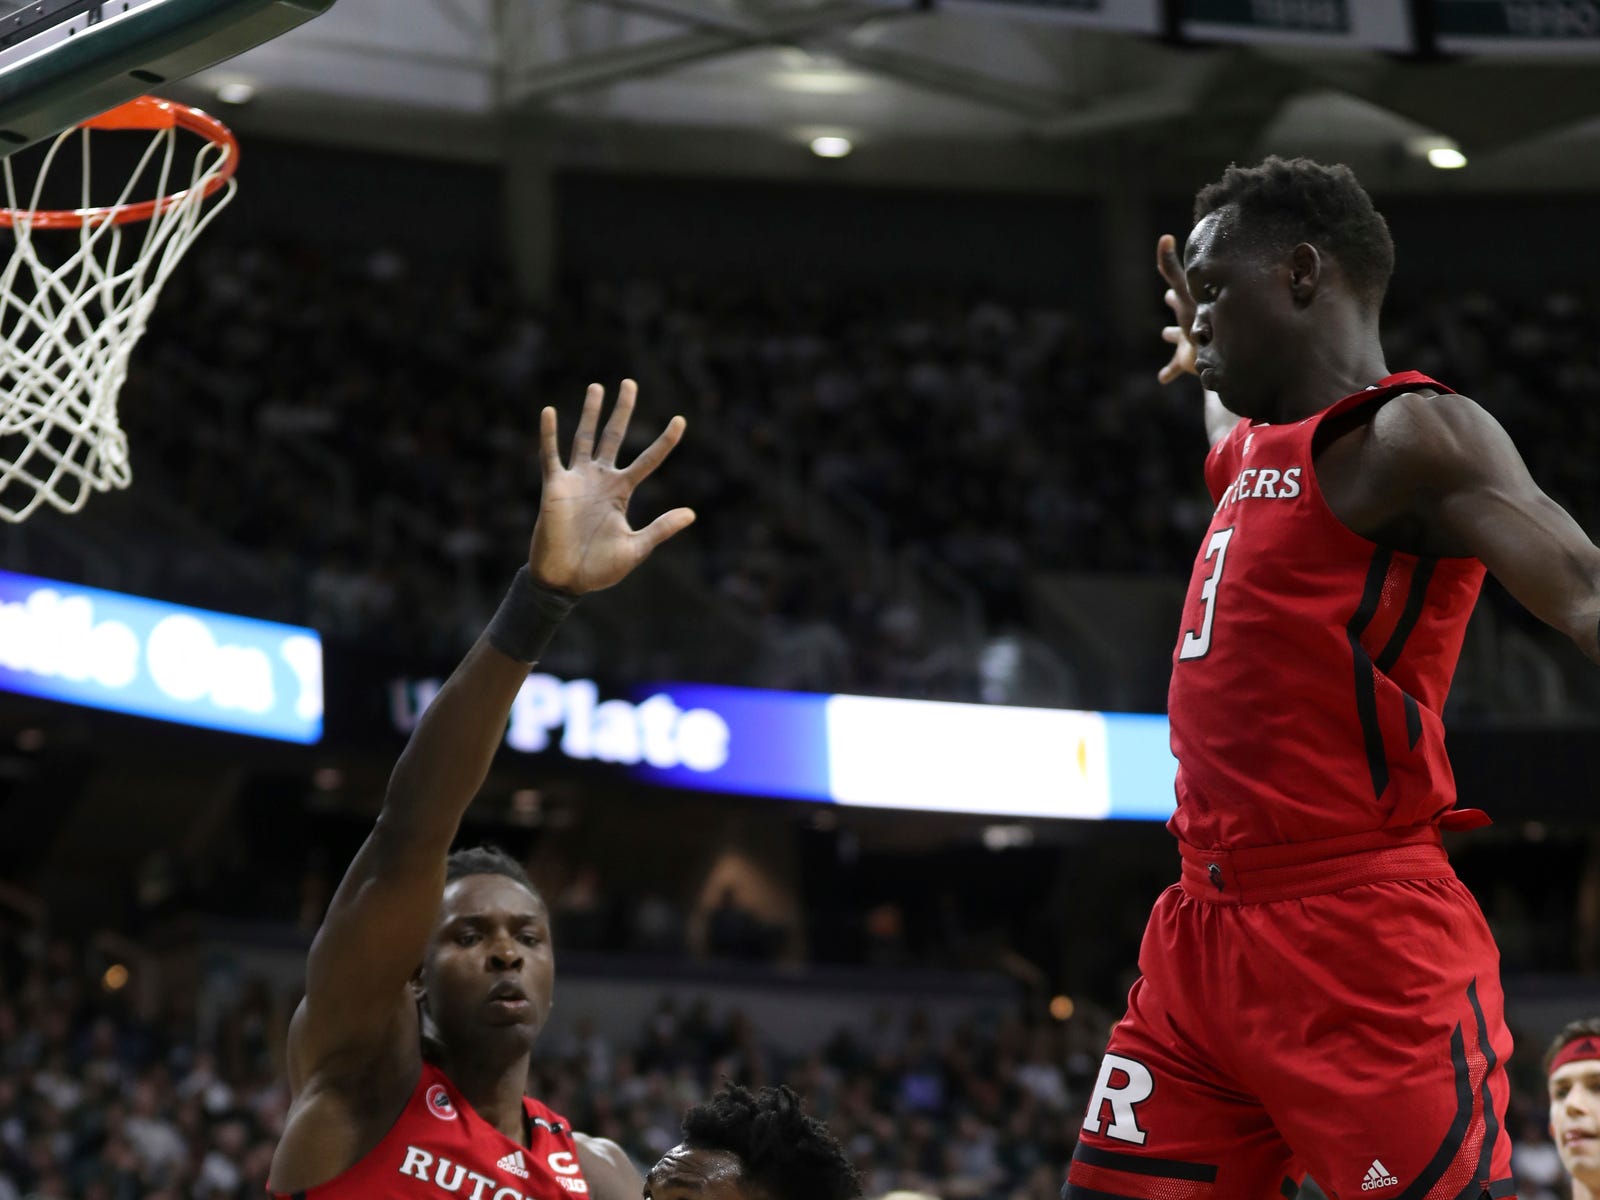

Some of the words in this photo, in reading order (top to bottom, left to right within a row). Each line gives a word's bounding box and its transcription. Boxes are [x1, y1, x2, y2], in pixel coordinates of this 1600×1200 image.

[1179, 526, 1235, 661] 3
[506, 672, 731, 772] Plate
[1082, 1052, 1155, 1146] R
[496, 1159, 530, 1180] adidas
[547, 1151, 579, 1175] C
[1361, 1175, 1399, 1192] adidas
